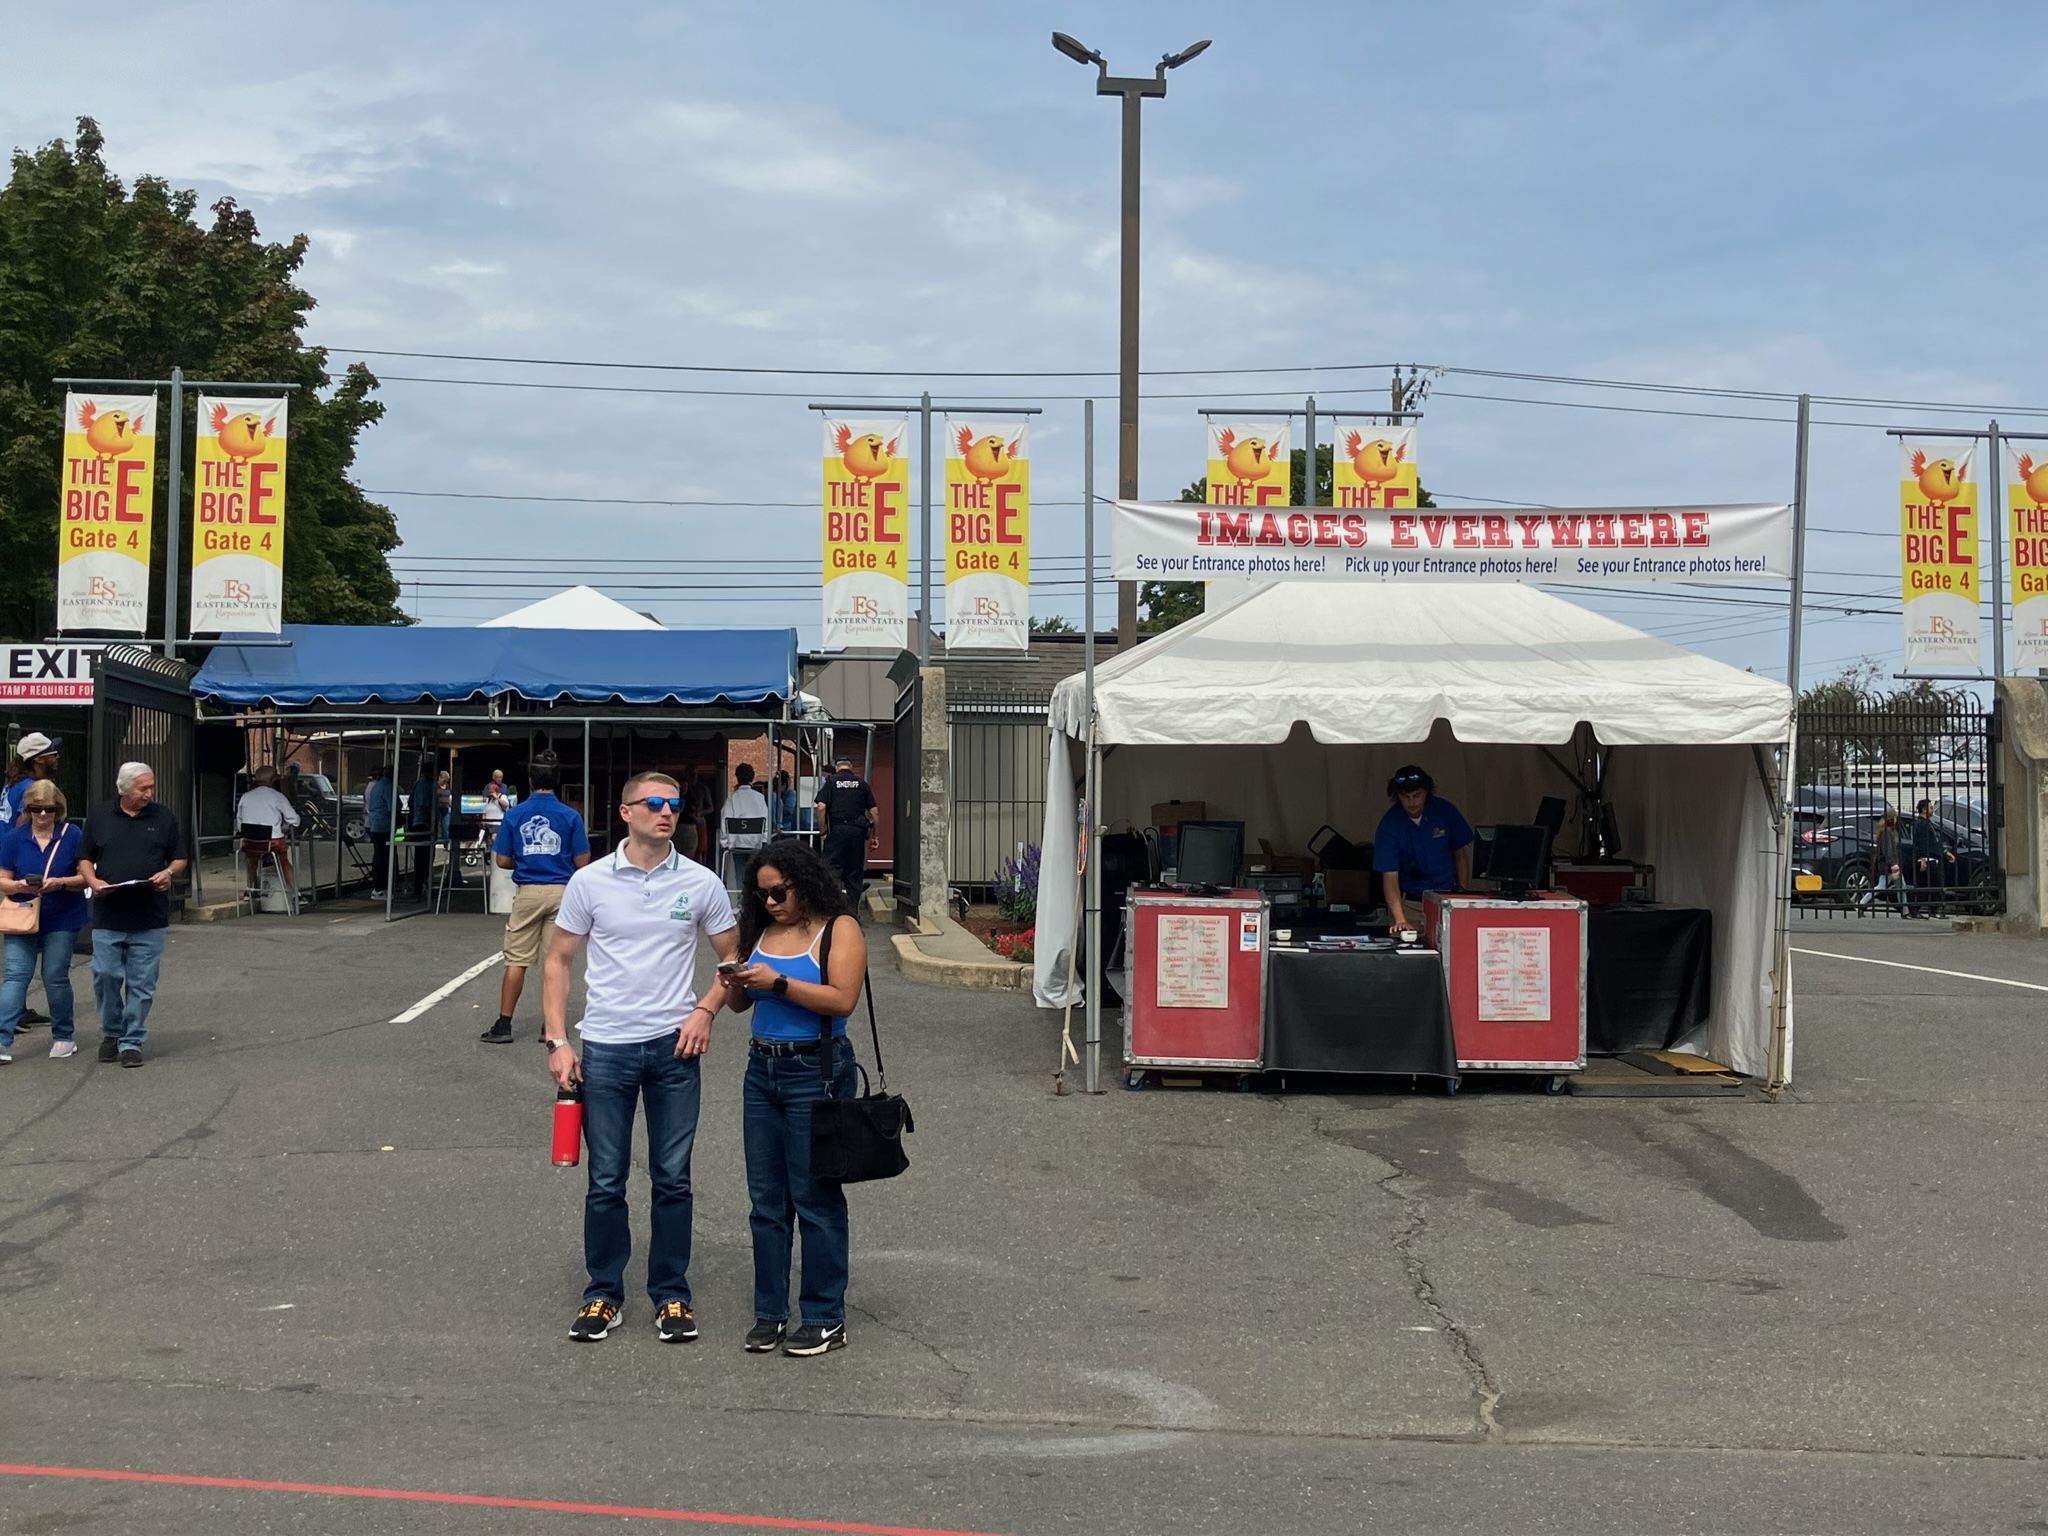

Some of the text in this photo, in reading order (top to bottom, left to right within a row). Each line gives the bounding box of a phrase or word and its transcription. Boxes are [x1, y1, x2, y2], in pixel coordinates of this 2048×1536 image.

[68, 459, 111, 485] THE
[202, 461, 245, 488] THE
[66, 461, 146, 522] BIG E
[200, 463, 279, 524] BIG E
[828, 482, 869, 507] THE
[950, 484, 991, 508] THE
[1211, 484, 1252, 505] THE
[1338, 487, 1379, 508] THE
[827, 483, 901, 543] BIG E
[951, 484, 1022, 543] BIG E
[1905, 504, 1943, 530] THE
[70, 528, 139, 549] Gate 4
[204, 530, 272, 551] Gate 4
[1197, 511, 1711, 549] IMAGES EVERYWHERE
[1906, 506, 1973, 564] BIG E
[832, 548, 897, 568] Gate 4
[955, 550, 1019, 570] Gate 4
[1136, 554, 1326, 577] See your Entrance photos here!
[1345, 556, 1557, 579] Pick up your Entrance photos here!
[1577, 555, 1766, 578] See your Entrance photos here!
[1911, 570, 1970, 590] Gate 4
[108, 600, 143, 608] STATES
[196, 601, 278, 610] EASTERN STATES
[827, 617, 868, 625] EASTERN
[949, 618, 1025, 627] EASTERN STATES
[1907, 636, 1977, 645] EASTERN STATES
[9, 649, 104, 678] EXIT
[29, 685, 76, 696] REQUIRED
[741, 820, 748, 830] 5
[677, 896, 689, 905] 43
